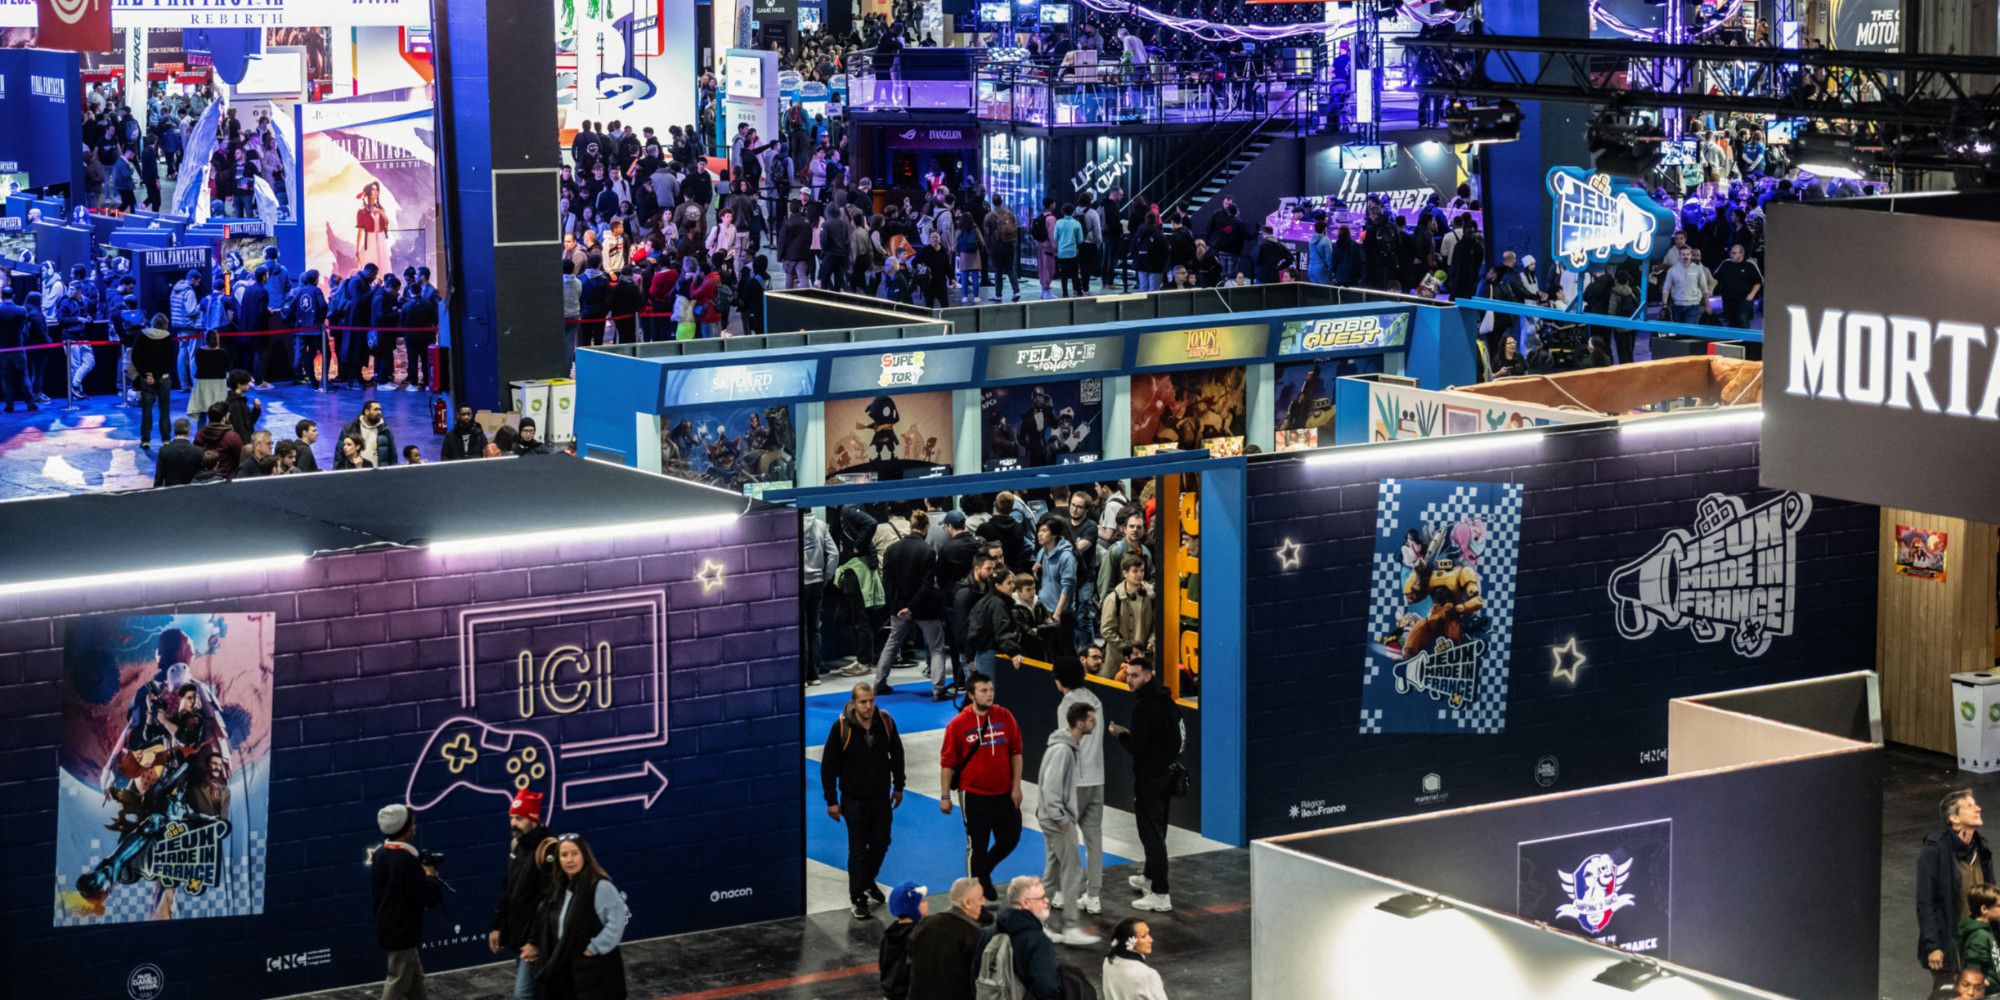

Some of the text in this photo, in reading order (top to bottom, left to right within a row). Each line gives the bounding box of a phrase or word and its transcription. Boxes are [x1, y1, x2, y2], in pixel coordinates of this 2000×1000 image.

[190, 14, 284, 25] REBIRTH
[1871, 10, 1894, 21] THE
[133, 27, 142, 84] TEKKE
[928, 129, 962, 140] EVANGELION
[375, 161, 421, 170] REBIRTH
[1070, 160, 1098, 193] UP
[1562, 203, 1609, 226] MADE
[145, 251, 167, 264] FINAL
[168, 249, 197, 263] FANTASY
[1313, 318, 1377, 334] ROBO
[1304, 329, 1381, 349] QUEST
[881, 352, 925, 367] SUPER
[1679, 503, 1783, 569] JEUX
[1680, 545, 1784, 591] MADE IN
[1680, 587, 1784, 629] FRANCE
[1426, 645, 1476, 666] JEUX
[518, 641, 612, 718] ICI
[1425, 661, 1475, 680] MADE IN
[1424, 678, 1474, 699] FRANCE
[154, 826, 216, 854] JEUX
[154, 846, 216, 864] MADE IN
[153, 864, 215, 885] FRANCE
[720, 887, 753, 900] nacon
[422, 933, 486, 949] ALIENWAR
[1620, 938, 1658, 952] FRANCE
[266, 952, 307, 972] CNC
